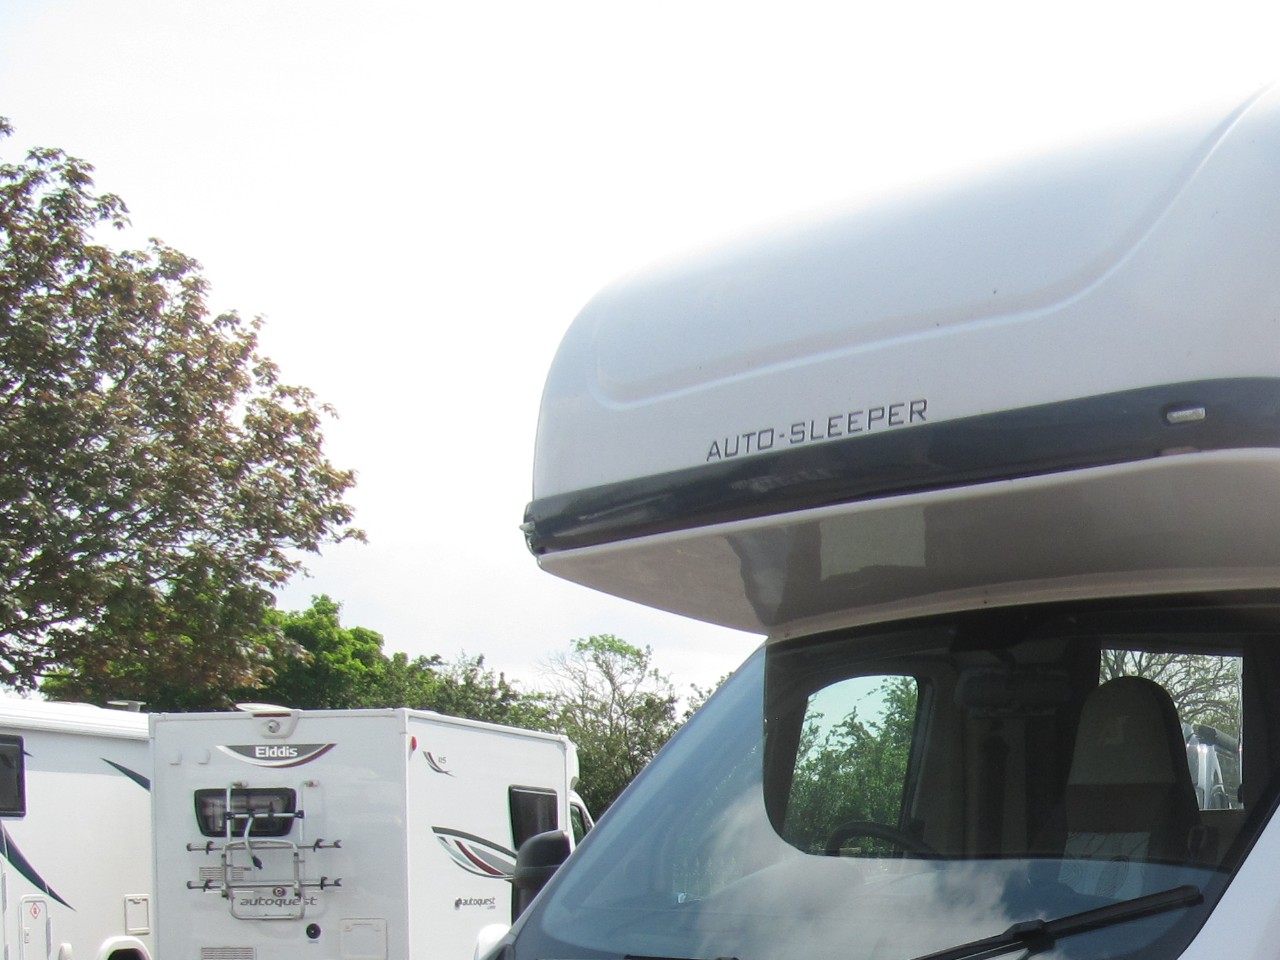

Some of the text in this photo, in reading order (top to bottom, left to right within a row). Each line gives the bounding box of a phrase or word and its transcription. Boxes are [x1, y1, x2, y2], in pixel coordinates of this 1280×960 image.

[705, 398, 928, 462] AUTO-SLEEPER
[254, 745, 298, 758] Elddis
[240, 896, 318, 908] autoquest
